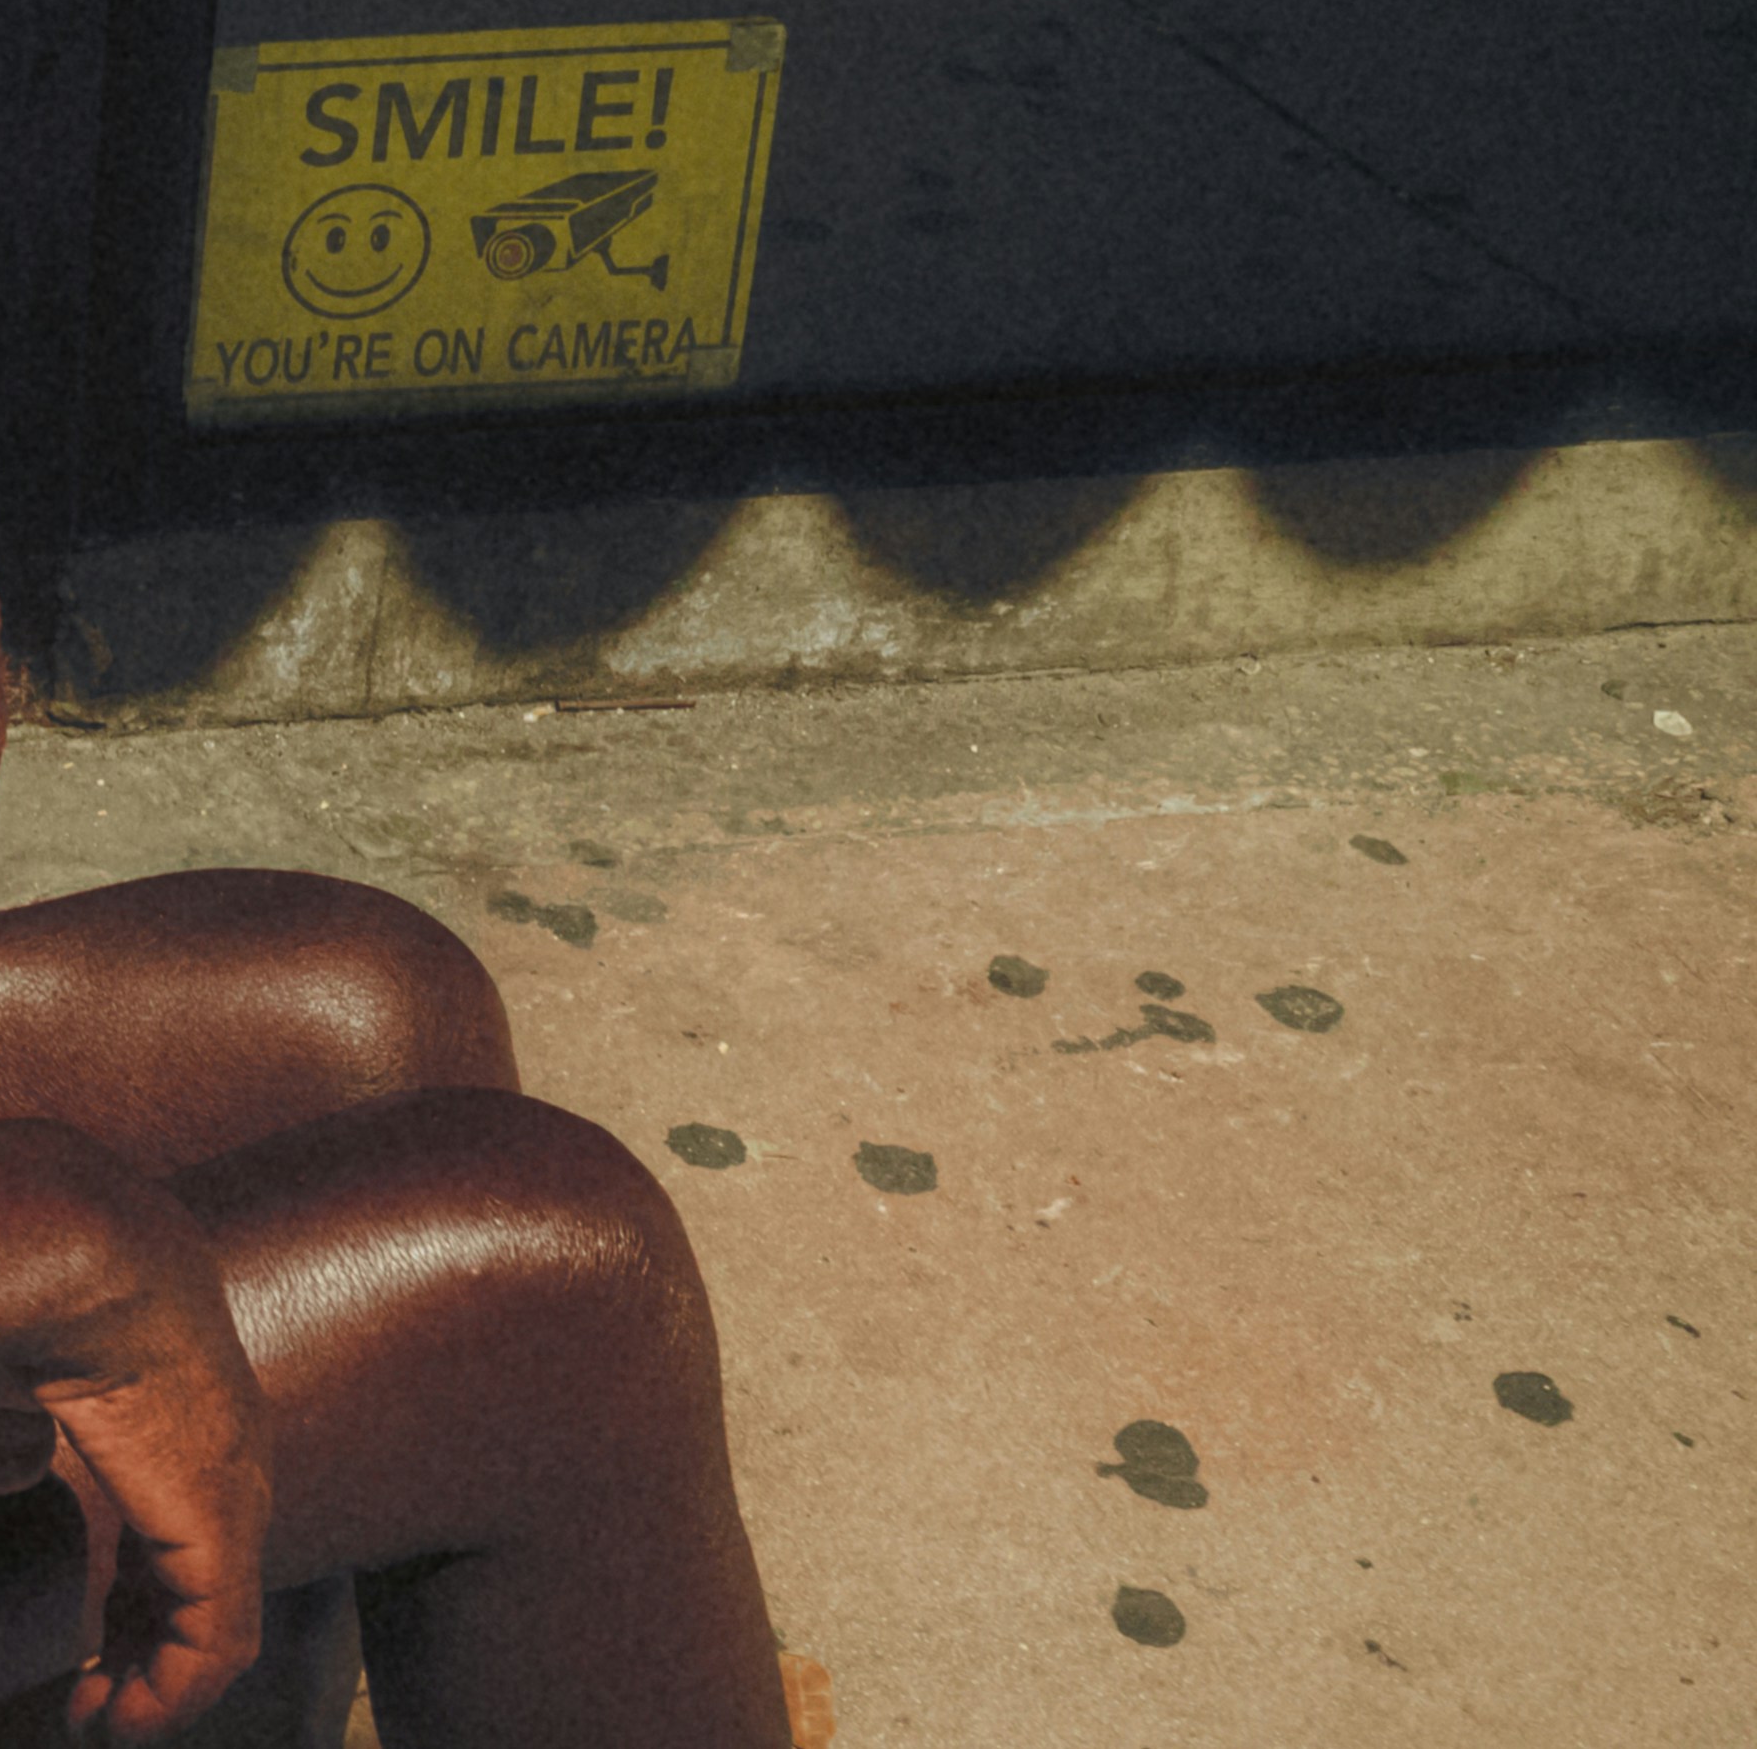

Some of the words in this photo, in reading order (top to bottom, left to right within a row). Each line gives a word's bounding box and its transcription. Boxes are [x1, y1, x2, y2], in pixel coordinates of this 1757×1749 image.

[299, 66, 675, 168] SMILE!
[214, 331, 394, 388] YOU'RE
[412, 326, 485, 377] ON
[506, 315, 698, 373] CAMERA
